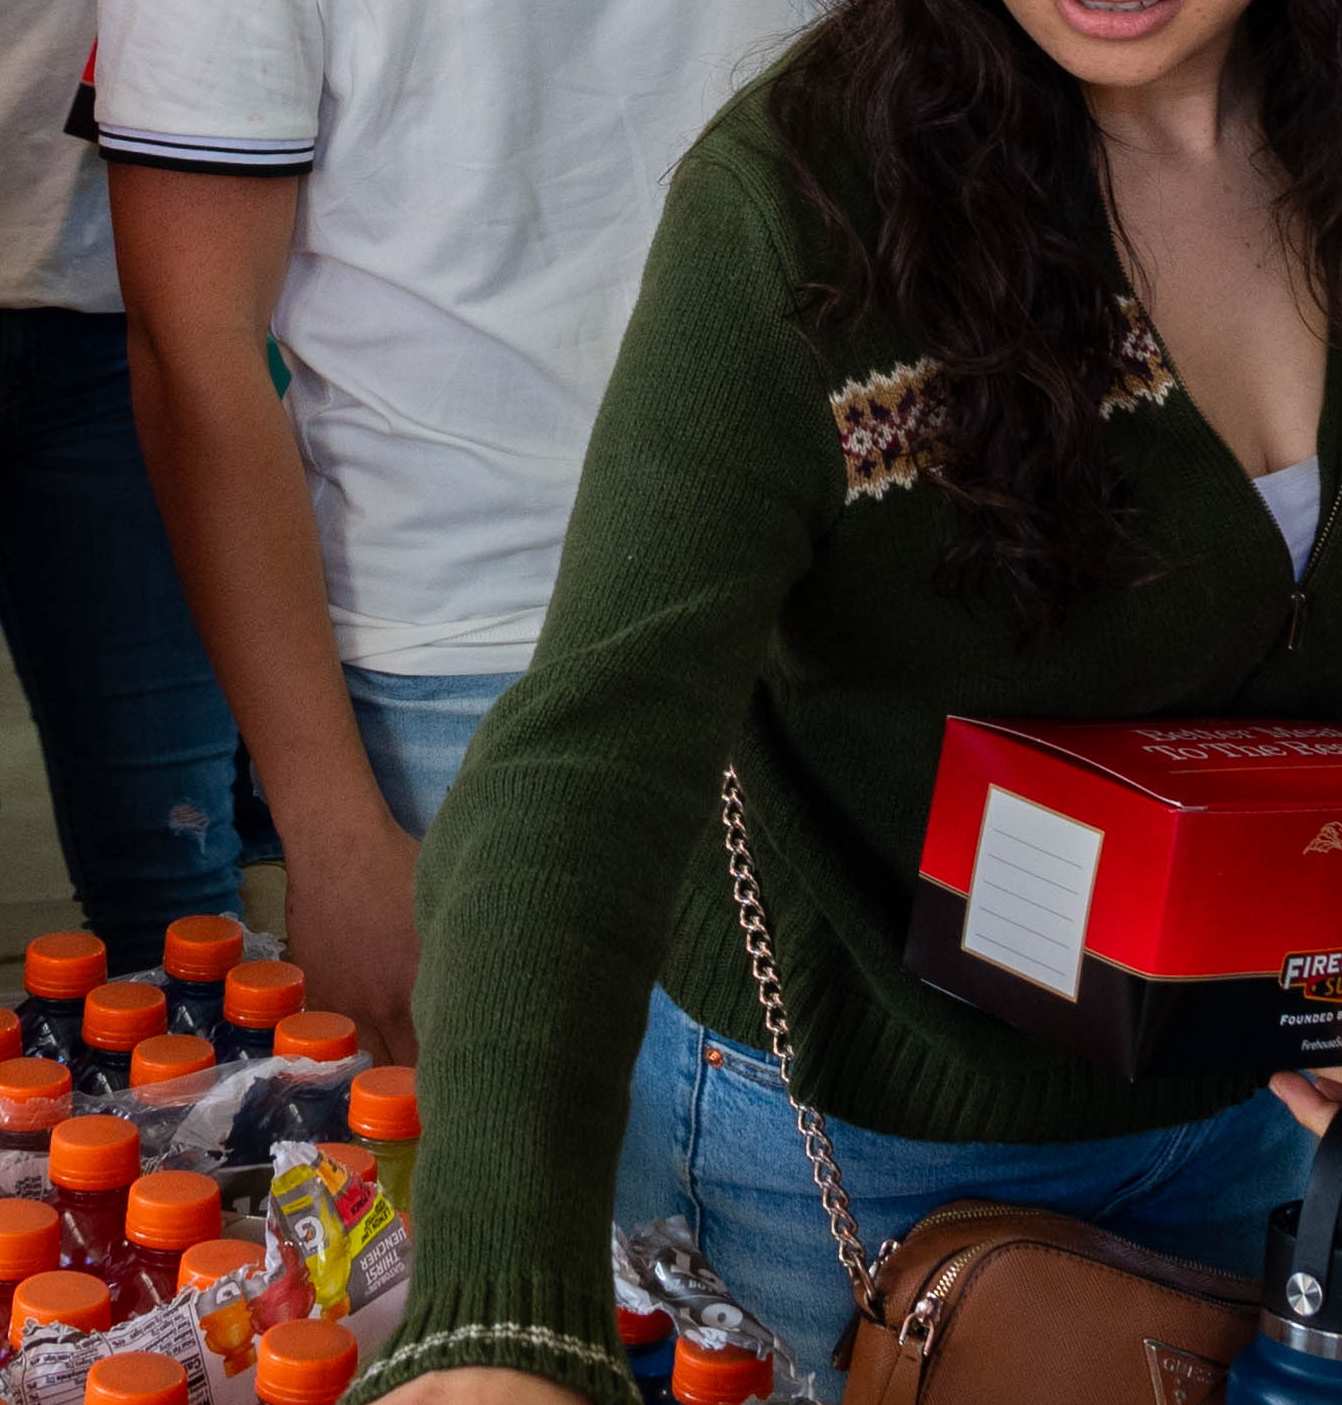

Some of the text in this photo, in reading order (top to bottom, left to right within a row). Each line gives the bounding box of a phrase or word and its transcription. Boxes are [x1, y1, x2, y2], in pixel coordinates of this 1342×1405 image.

[1131, 727, 1258, 742] Better
[1143, 744, 1209, 761] To
[1199, 742, 1287, 758] The
[1279, 1010, 1334, 1027] FOUNDED
[360, 1226, 407, 1271] UENCHER
[365, 1248, 401, 1285] THIRST
